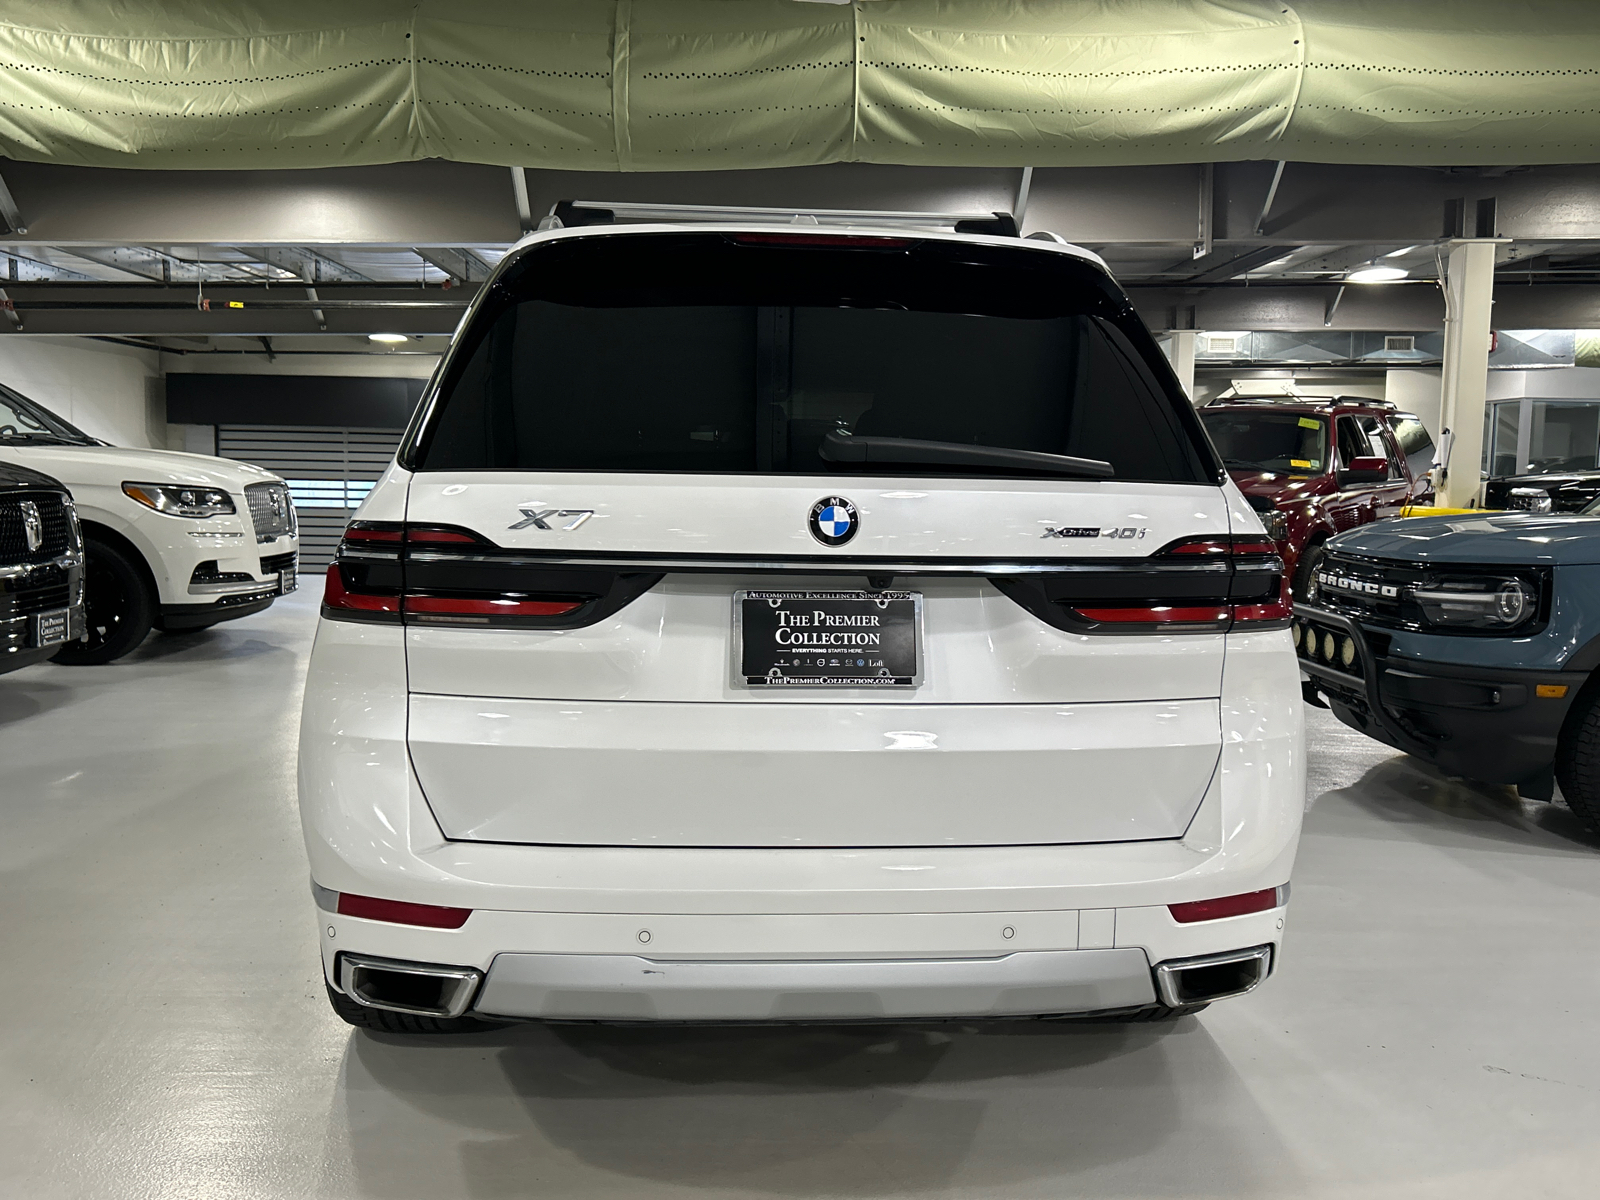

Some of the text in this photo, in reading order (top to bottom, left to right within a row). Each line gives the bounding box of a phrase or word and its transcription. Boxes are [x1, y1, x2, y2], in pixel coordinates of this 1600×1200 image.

[814, 498, 855, 513] BMW
[507, 509, 594, 531] X7
[1101, 527, 1147, 539] 40i
[1318, 573, 1399, 597] BRONCO
[749, 591, 804, 599] AUTOMOTIVE
[775, 610, 880, 627] THE PREMIER
[775, 627, 881, 645] COLLECTION
